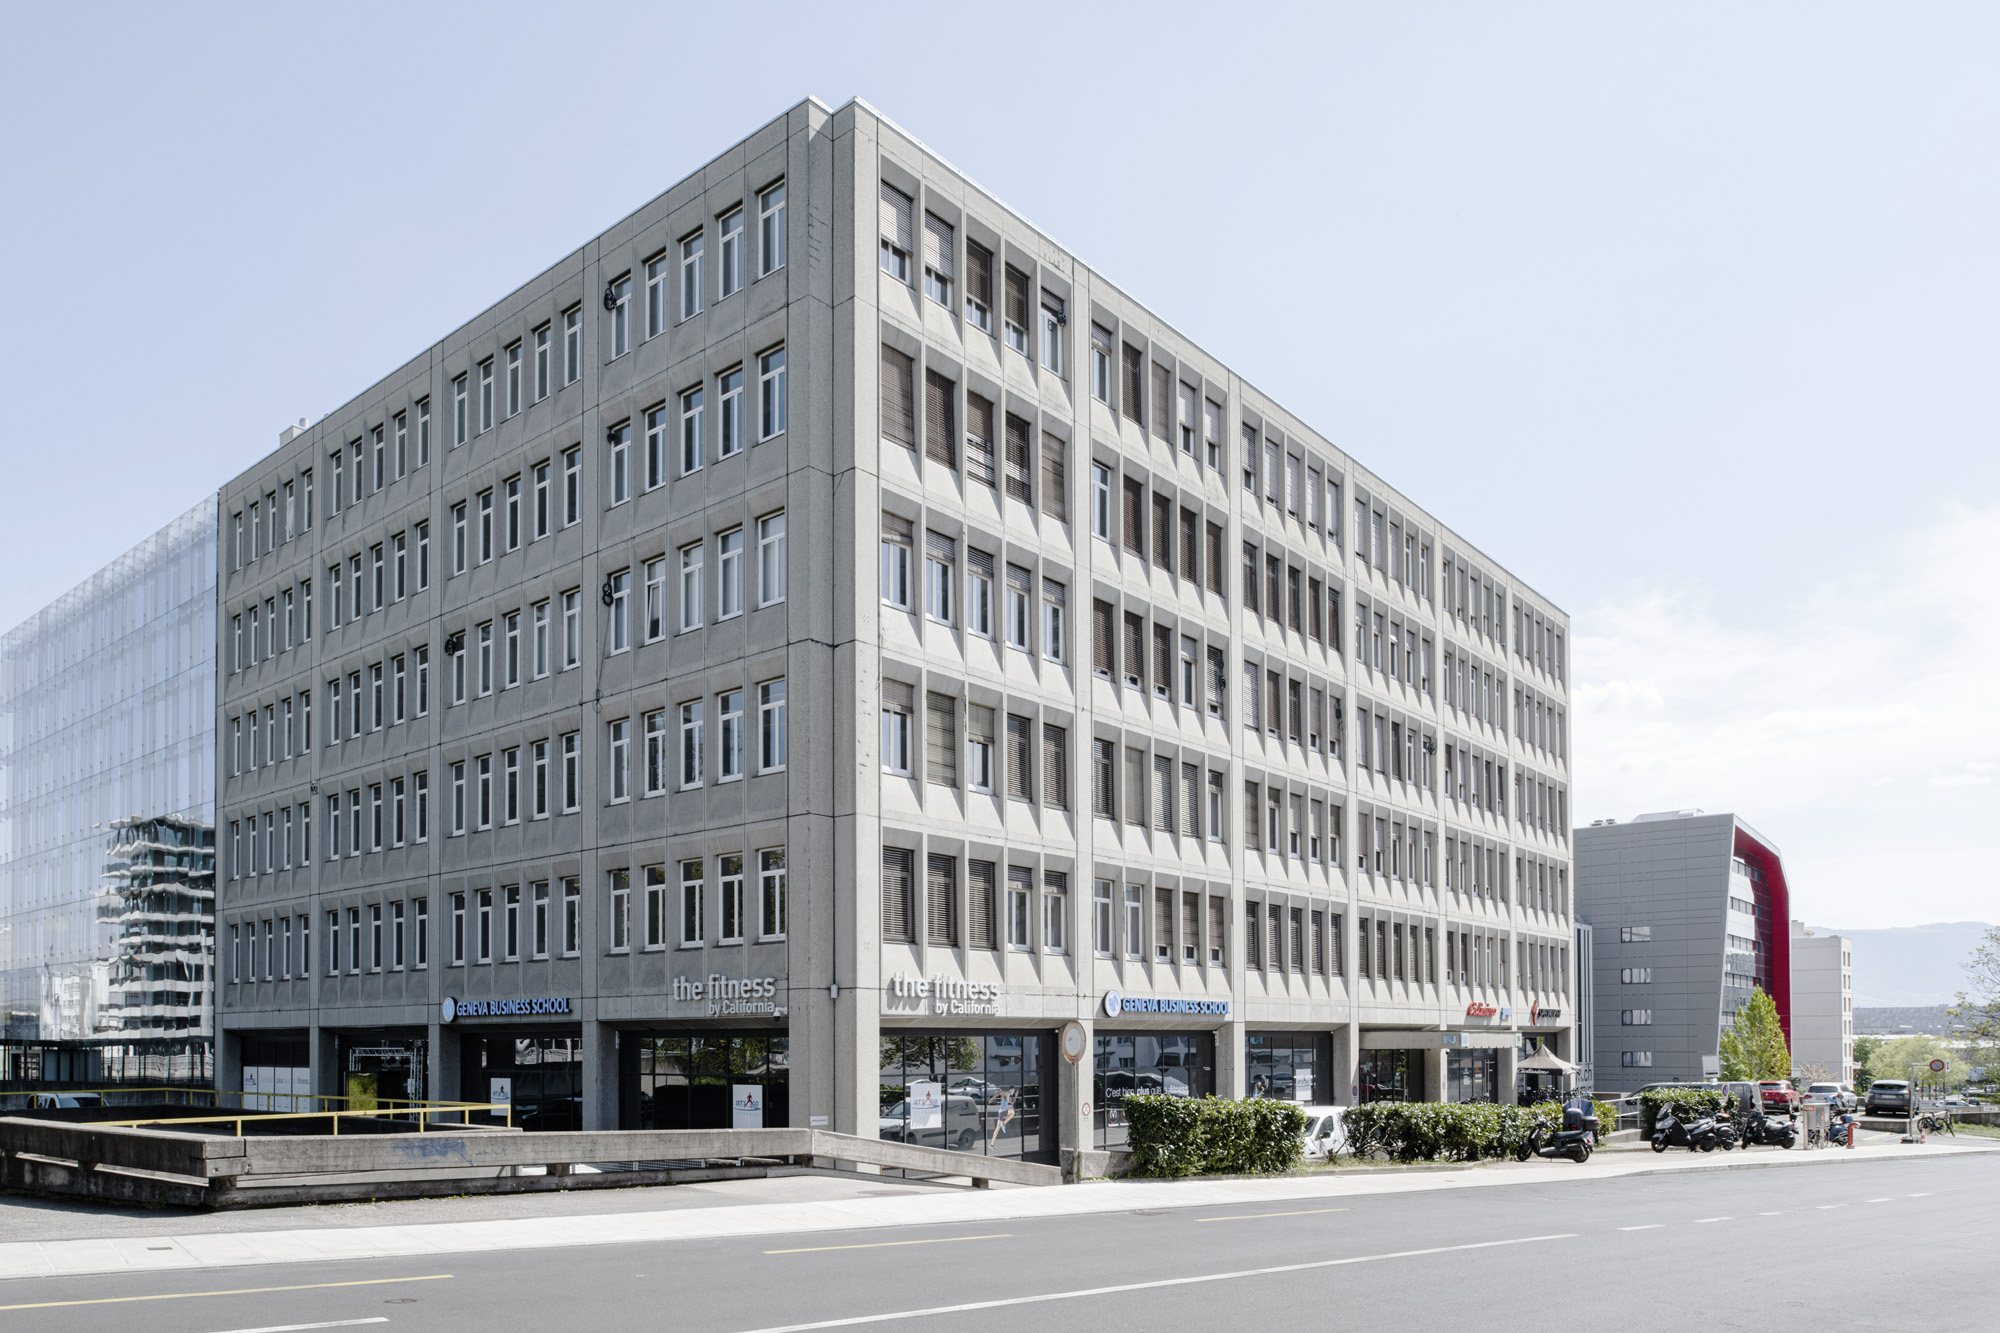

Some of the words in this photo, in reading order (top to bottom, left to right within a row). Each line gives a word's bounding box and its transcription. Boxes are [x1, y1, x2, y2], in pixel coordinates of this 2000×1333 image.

[673, 976, 704, 1001] the
[708, 974, 776, 999] fitness
[895, 971, 929, 997] the
[933, 973, 1000, 1000] fitness
[456, 1001, 489, 1016] GENEVA
[490, 998, 531, 1015] BUSINESS
[532, 997, 570, 1014] SCHOOL
[709, 1001, 720, 1017] by
[722, 999, 774, 1014] California
[936, 1000, 948, 1016] by
[950, 1000, 1000, 1015] California
[1122, 998, 1159, 1012] GENEVA
[1159, 999, 1199, 1013] BUSINESS
[1200, 1001, 1231, 1015] SCHOOL
[1106, 1088, 1121, 1098] C'est
[1136, 1086, 1150, 1097] plus
